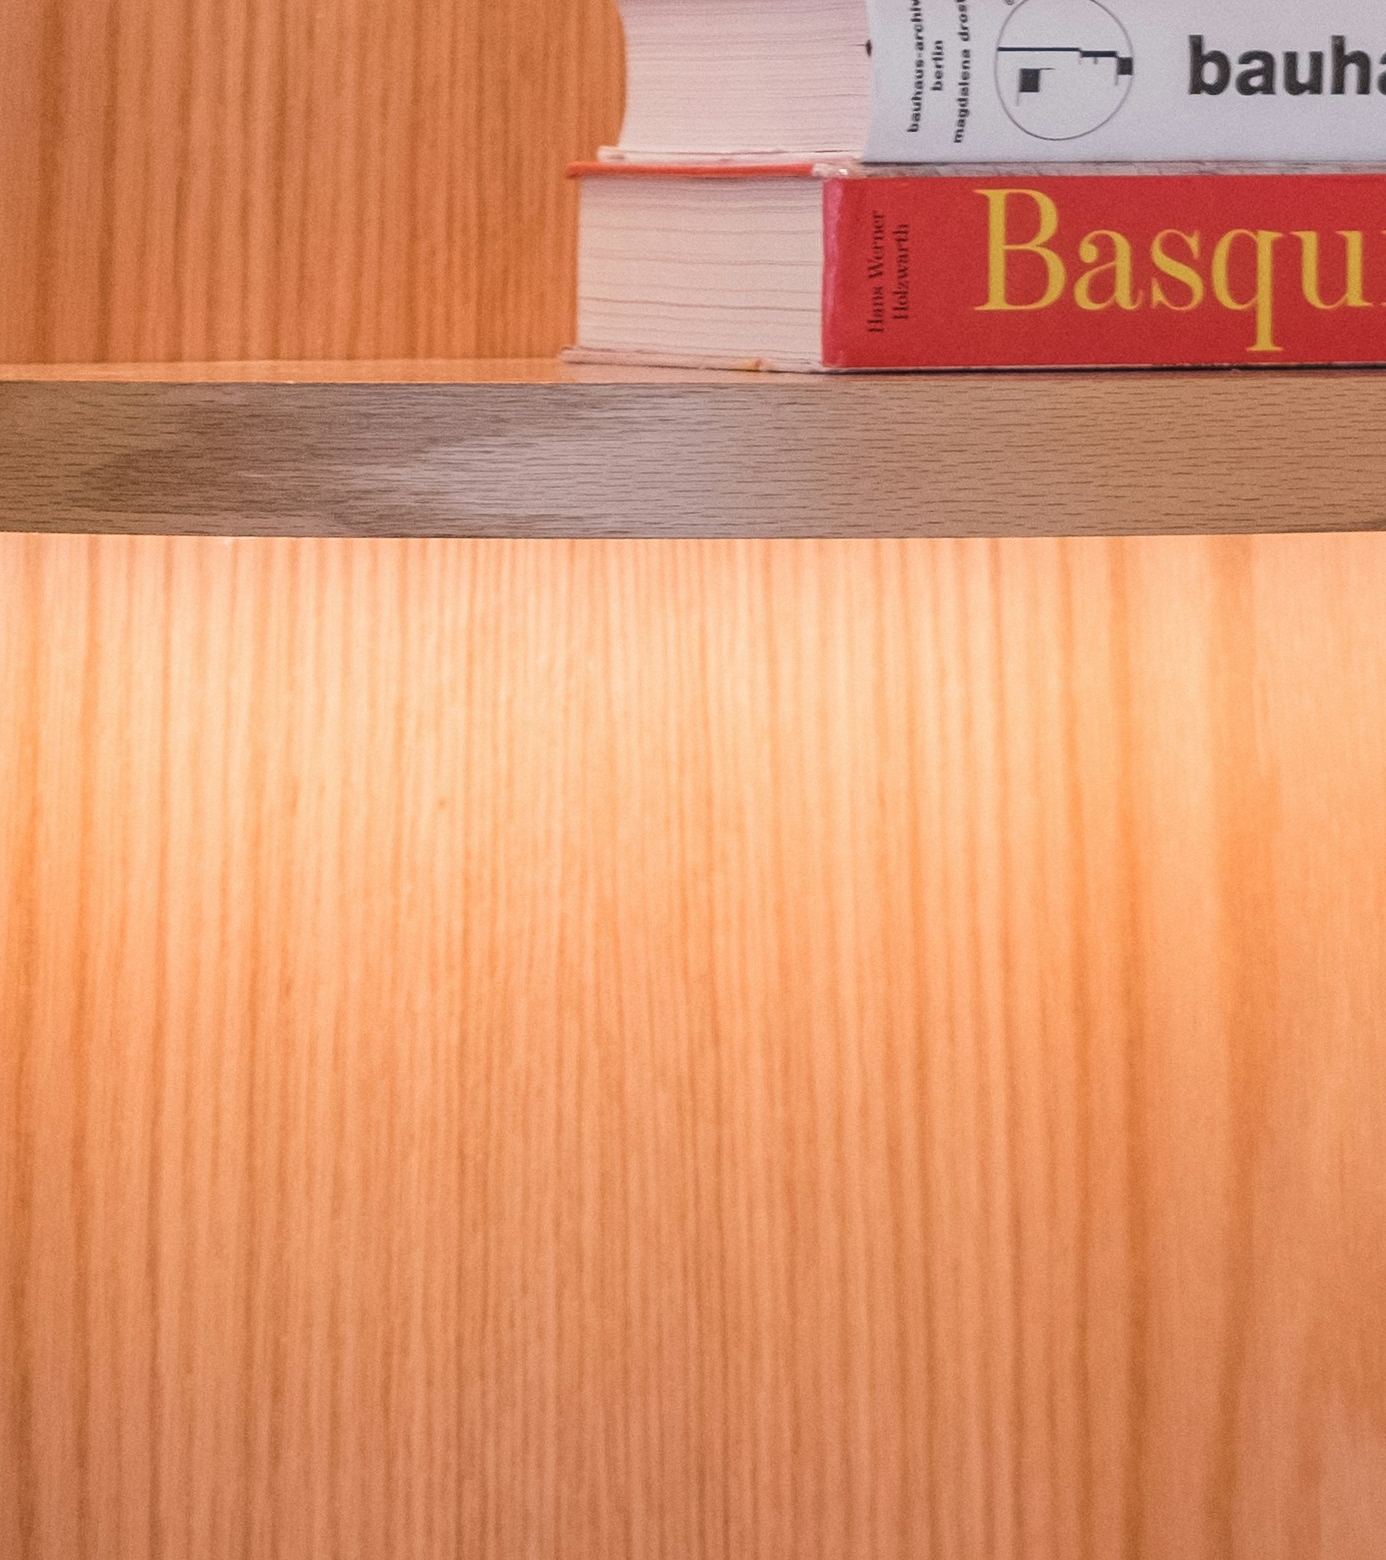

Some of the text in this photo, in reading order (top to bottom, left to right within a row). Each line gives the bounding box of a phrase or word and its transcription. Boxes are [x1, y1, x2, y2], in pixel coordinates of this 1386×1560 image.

[930, 40, 944, 92] berlin
[953, 49, 971, 144] magdalena
[867, 211, 885, 333] Hans Werner
[891, 224, 909, 321] Holzwarth
